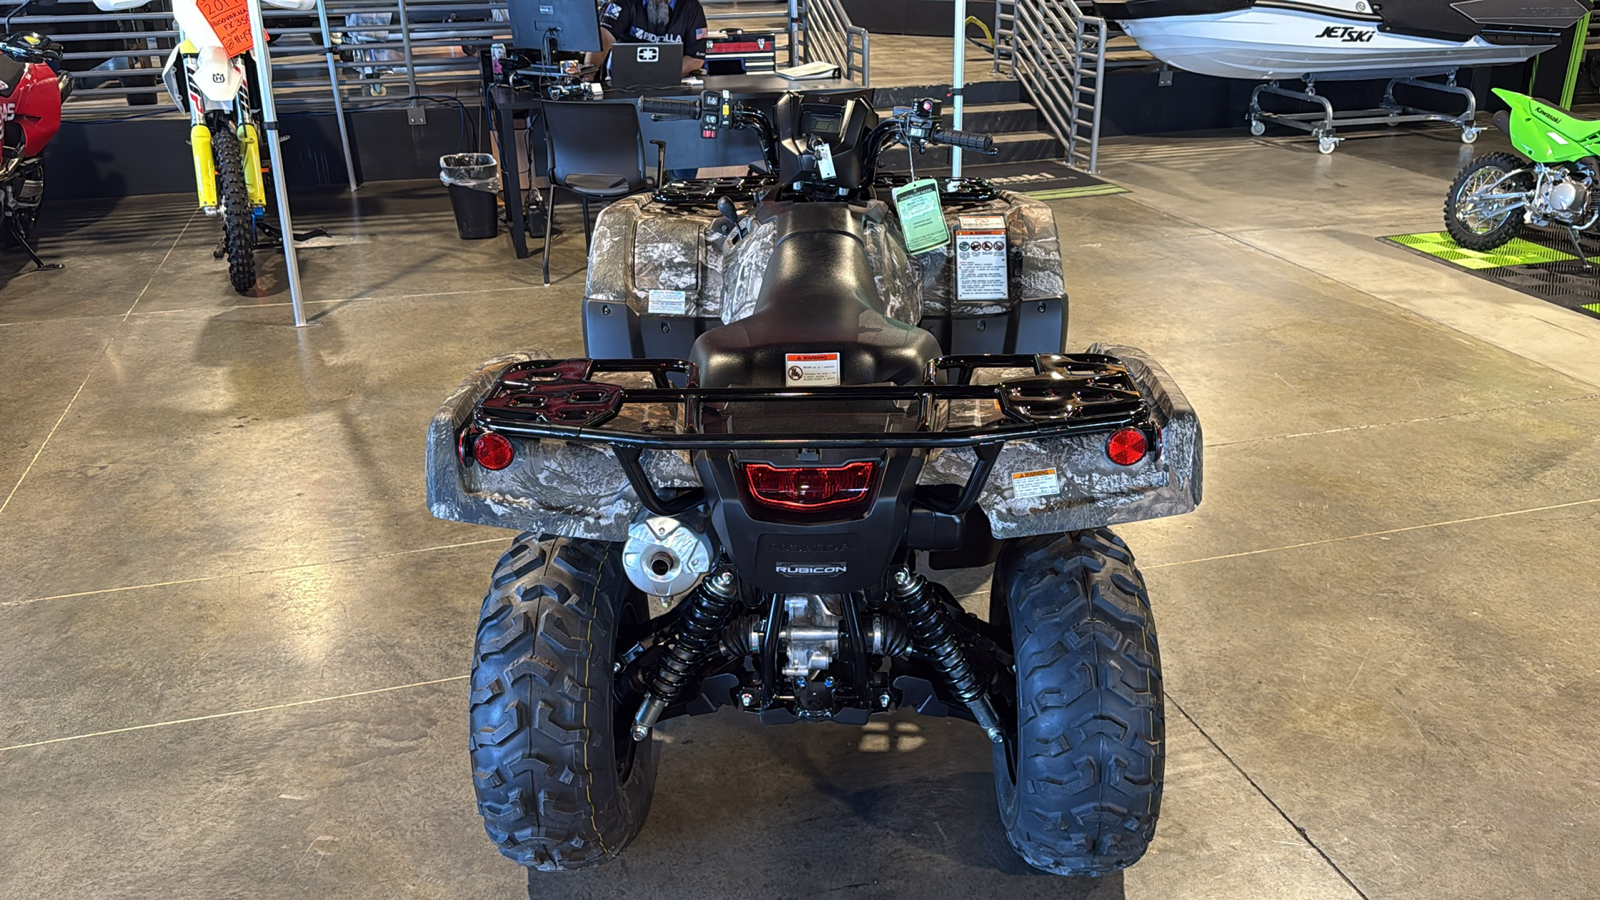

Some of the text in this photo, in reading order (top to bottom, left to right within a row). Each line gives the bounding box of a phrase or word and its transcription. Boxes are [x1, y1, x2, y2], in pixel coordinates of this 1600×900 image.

[204, 0, 239, 15] 201
[1535, 106, 1562, 124] Kawasaki
[1025, 470, 1049, 478] WARNING
[775, 566, 847, 574] RUBICON
